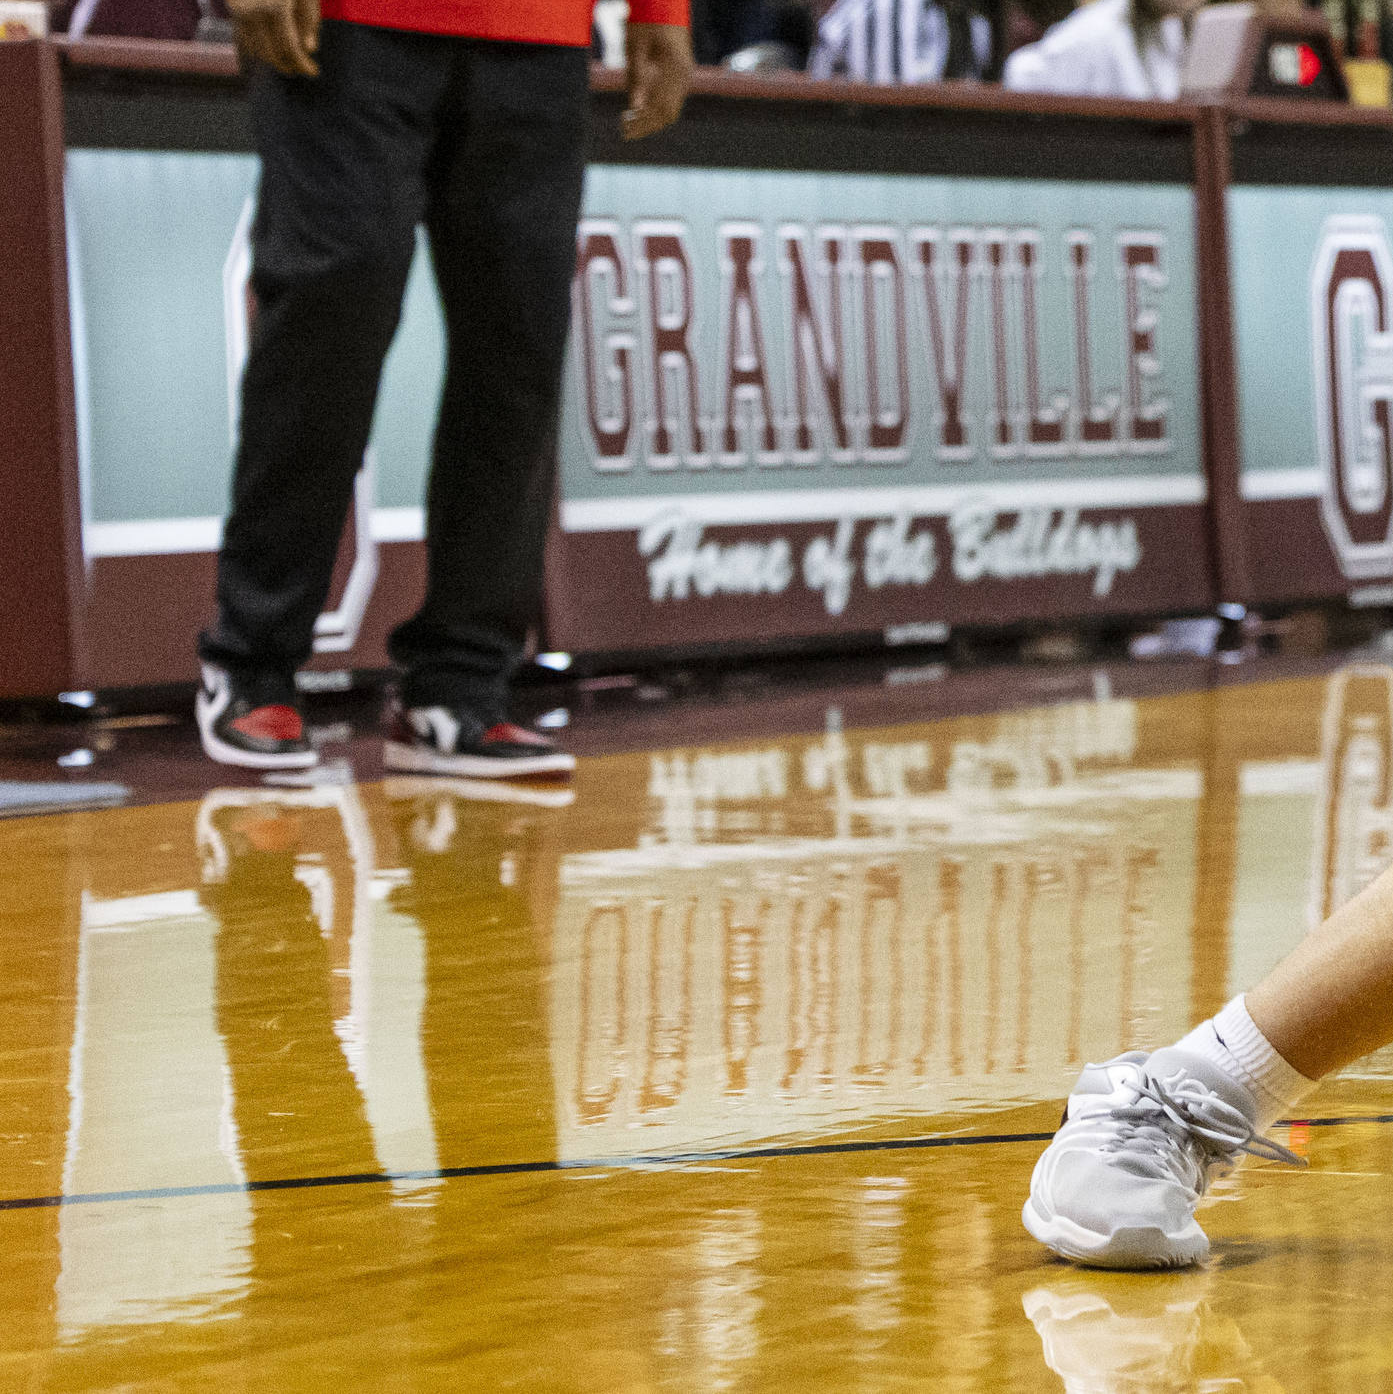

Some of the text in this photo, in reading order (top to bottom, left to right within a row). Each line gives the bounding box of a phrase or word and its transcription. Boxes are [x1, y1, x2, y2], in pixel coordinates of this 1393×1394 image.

[571, 219, 1170, 472] GRANDVILLE
[638, 492, 1142, 616] Home of the Bulldogs
